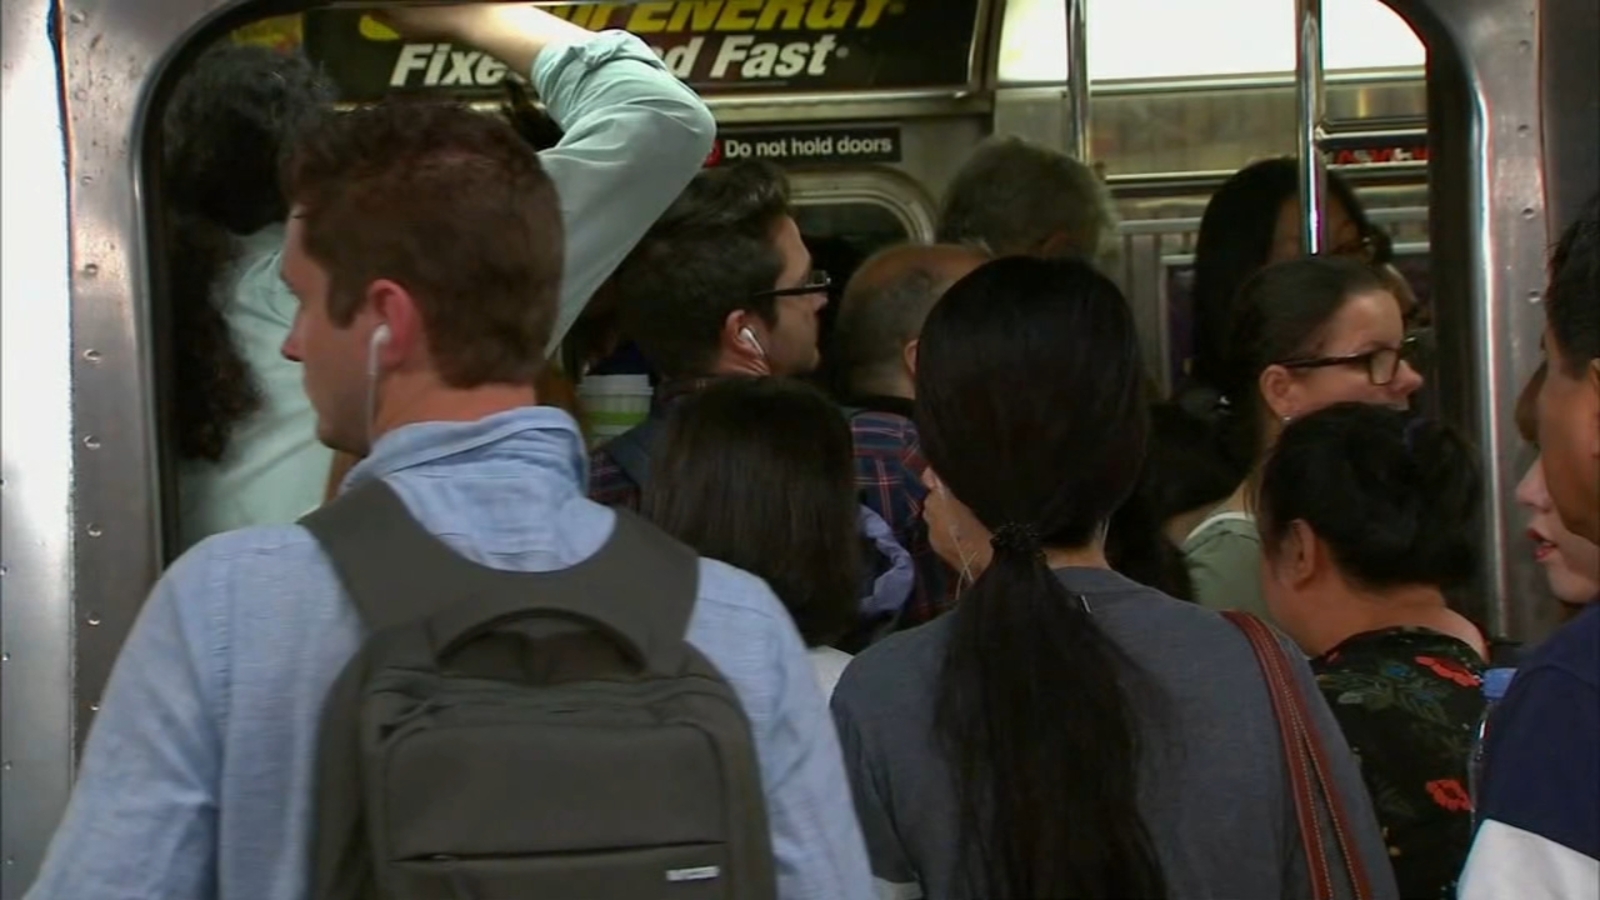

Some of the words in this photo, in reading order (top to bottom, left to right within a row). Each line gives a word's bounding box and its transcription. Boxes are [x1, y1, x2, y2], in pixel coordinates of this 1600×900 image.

[390, 43, 509, 86] Fixe
[709, 34, 837, 79] Fast
[724, 140, 752, 158] Do
[756, 140, 787, 156] not
[792, 137, 832, 155] hold
[838, 136, 892, 154] doors
